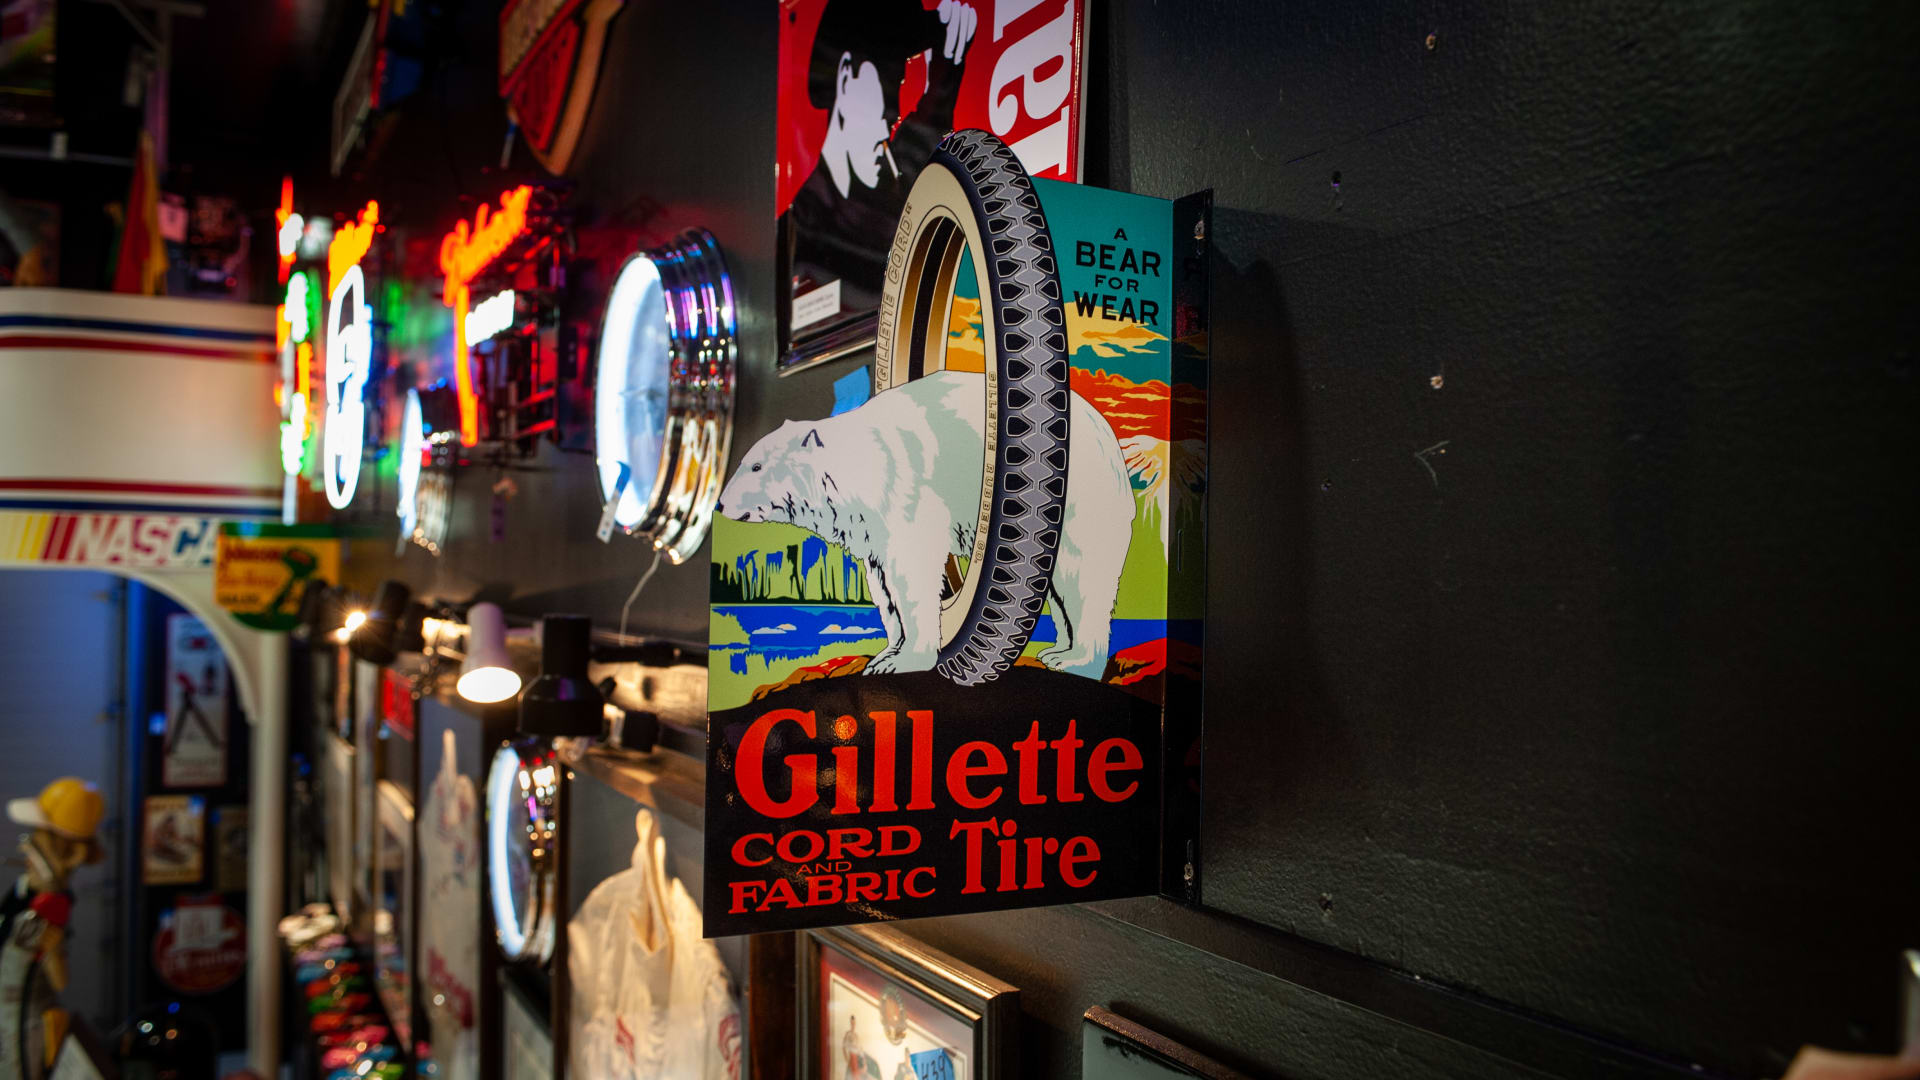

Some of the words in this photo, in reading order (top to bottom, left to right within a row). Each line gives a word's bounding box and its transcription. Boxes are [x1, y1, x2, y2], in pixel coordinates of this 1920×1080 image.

[1113, 228, 1128, 241] A
[1075, 240, 1161, 277] BEAR
[1095, 274, 1139, 293] FOR
[1073, 291, 1159, 326] WEAR
[988, 371, 998, 451] GILLETTE
[980, 463, 994, 534] RUBBER
[735, 708, 1143, 819] Gillette
[731, 825, 922, 867] CORD
[950, 816, 1101, 894] Tire
[796, 861, 852, 875] AND
[728, 867, 936, 914] FABRIC
